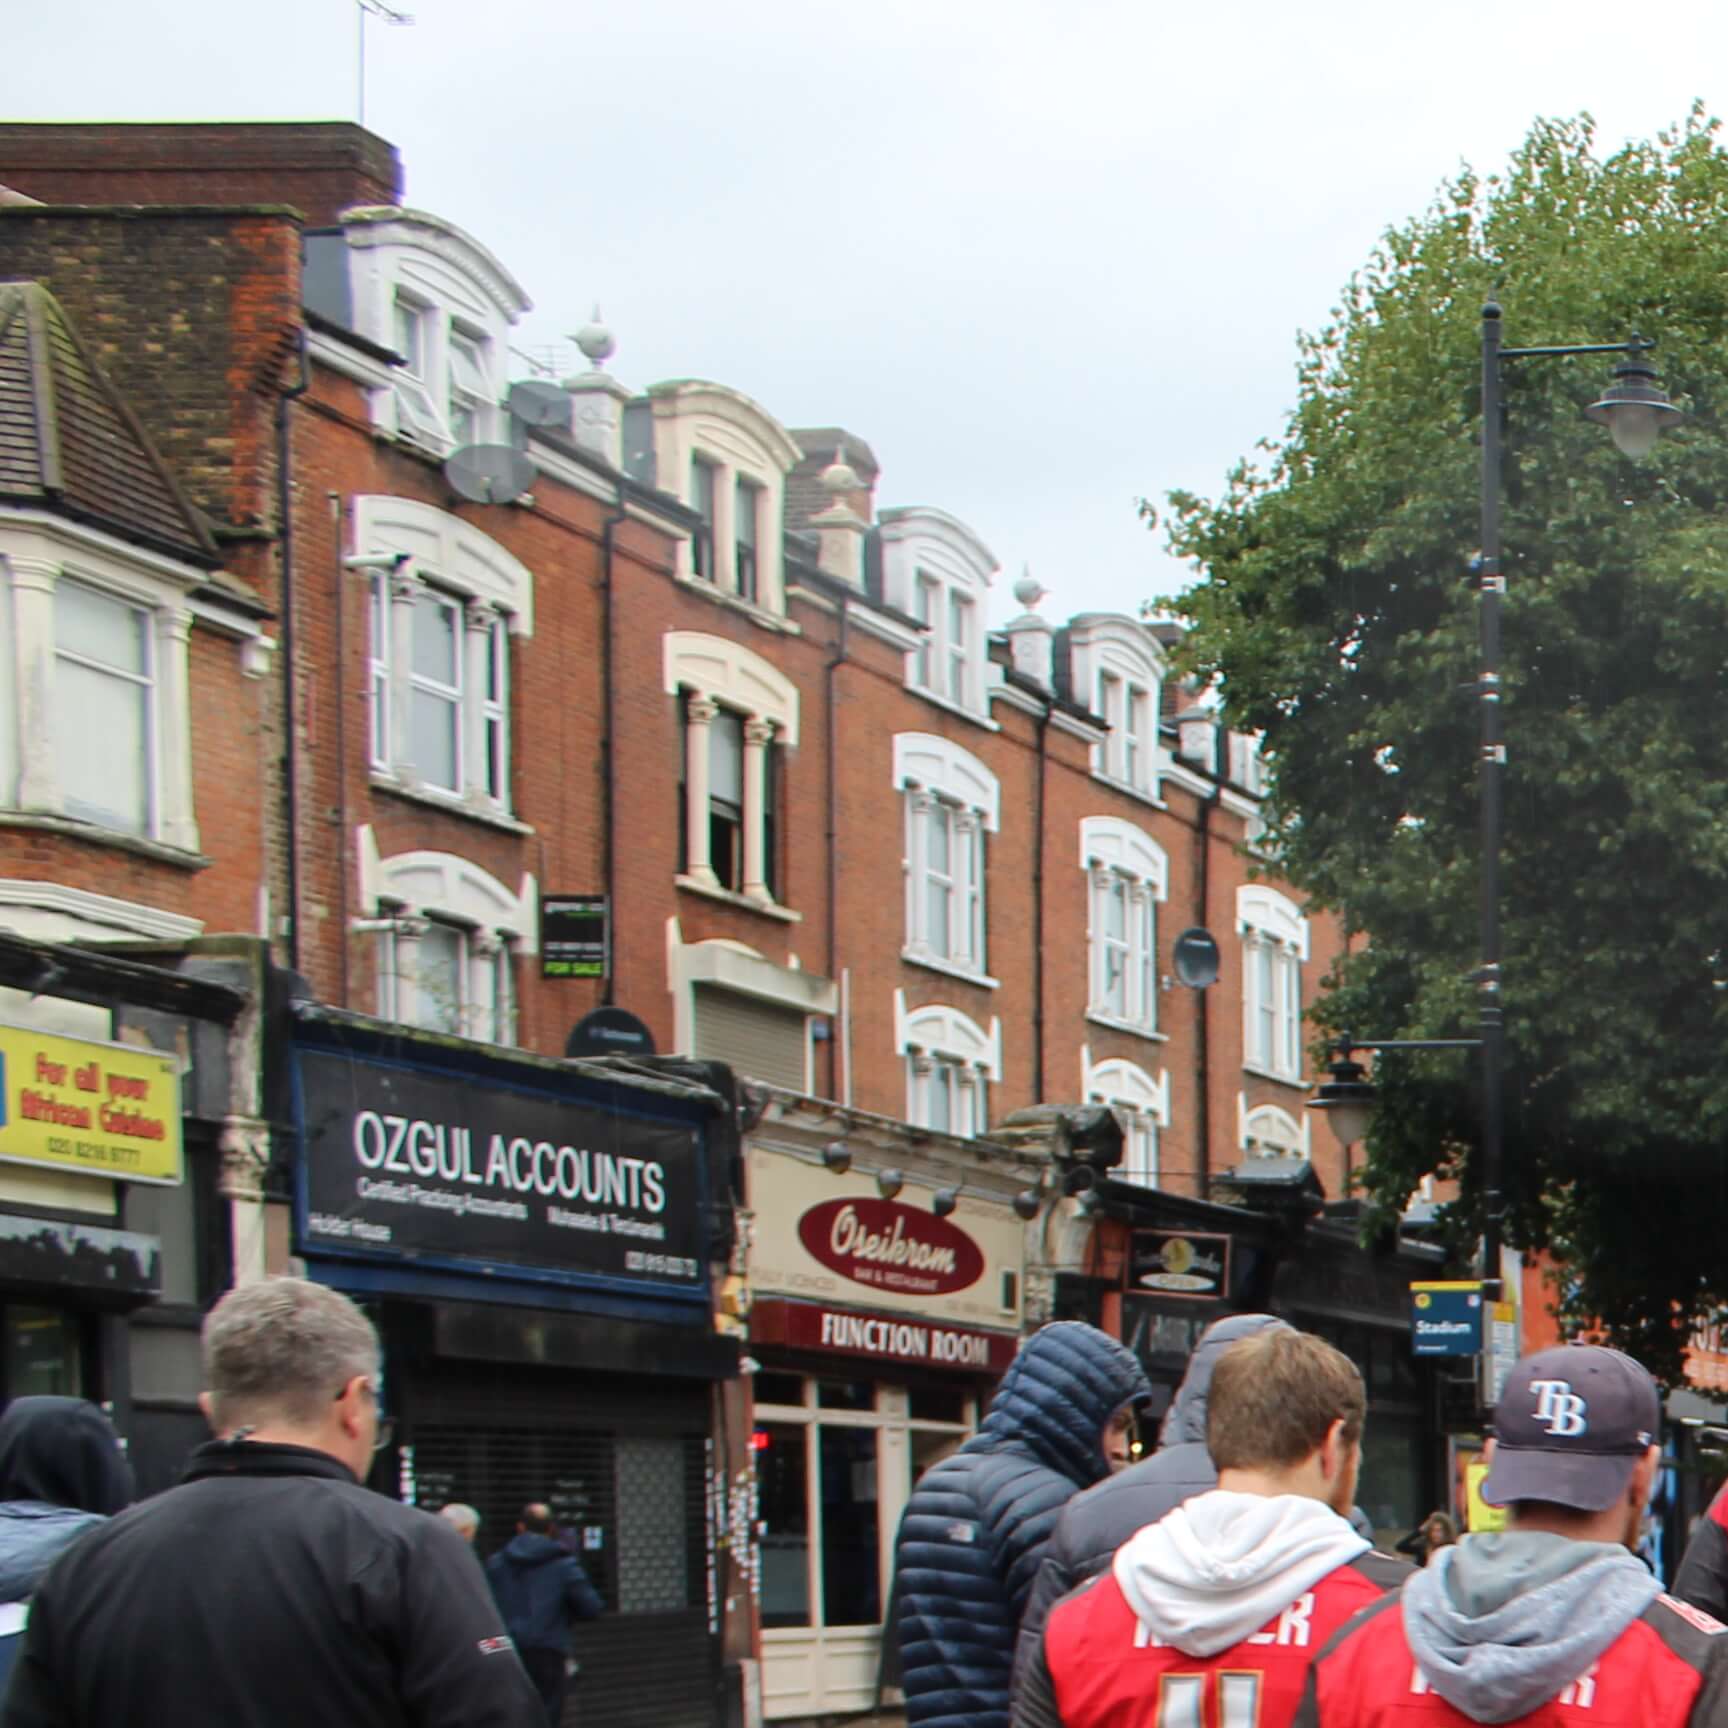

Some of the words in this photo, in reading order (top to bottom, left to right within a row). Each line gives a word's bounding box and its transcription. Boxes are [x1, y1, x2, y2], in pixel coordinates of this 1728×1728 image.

[544, 962, 572, 975] FOR
[573, 962, 604, 975] SALE
[352, 1109, 483, 1185] OZGUL
[486, 1133, 667, 1213] ACCOUNTS
[831, 1204, 956, 1275] Oseikrom
[821, 1313, 928, 1358] FUNCTION
[931, 1329, 989, 1366] ROOM
[1416, 1320, 1472, 1334] Stadium
[1528, 1380, 1587, 1437] TB
